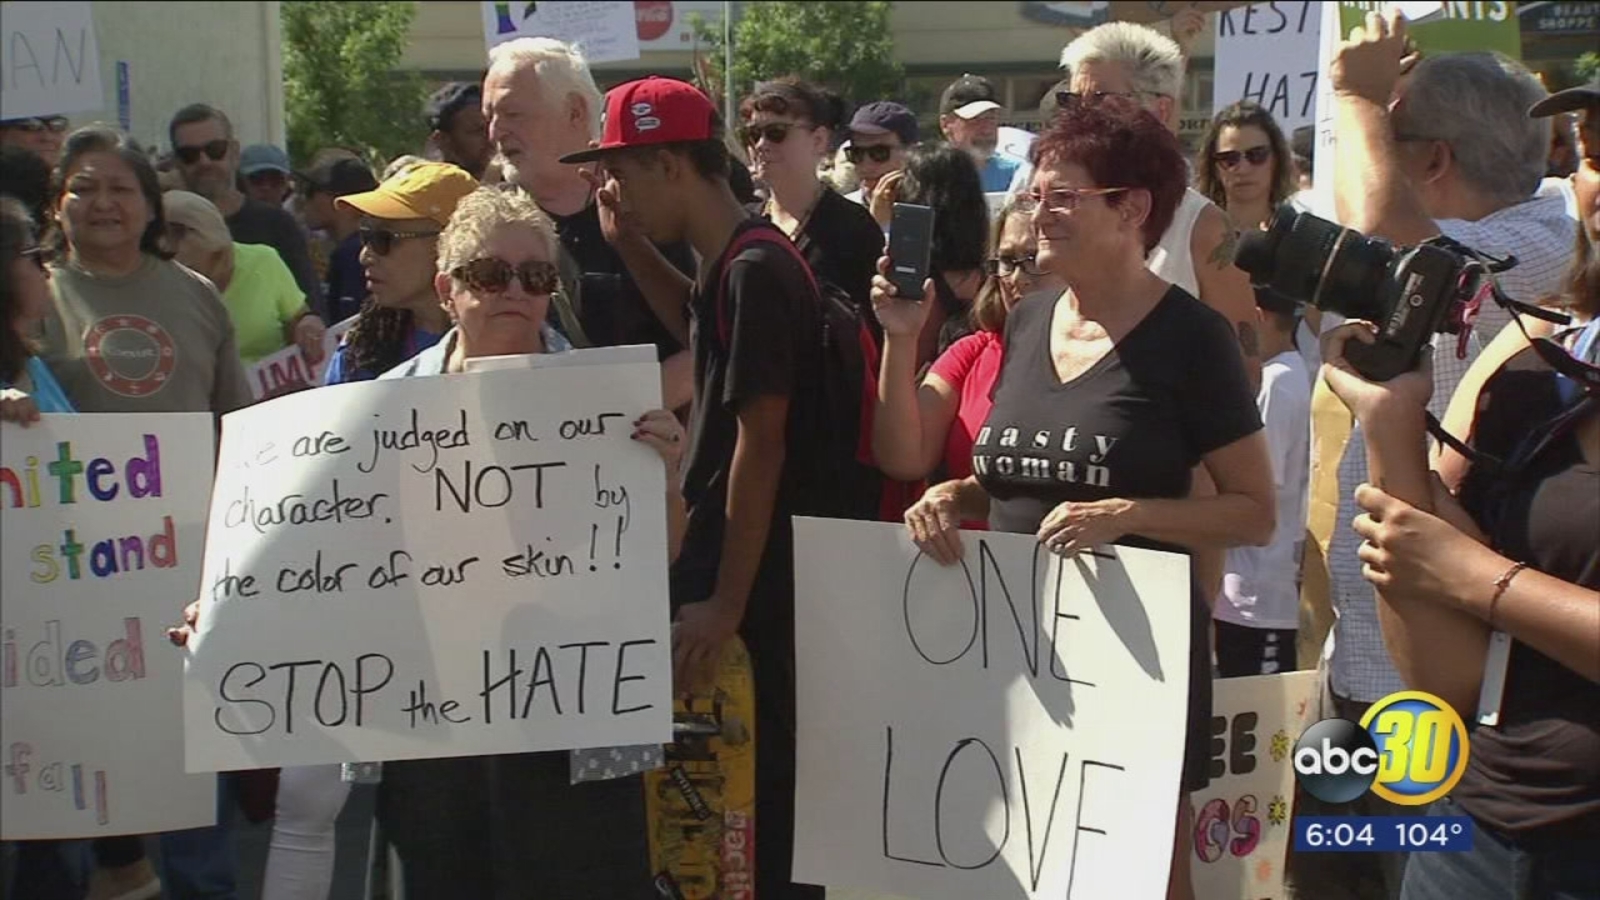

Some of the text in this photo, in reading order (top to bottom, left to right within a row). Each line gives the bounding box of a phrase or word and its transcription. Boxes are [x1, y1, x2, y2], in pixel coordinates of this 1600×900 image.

[1243, 71, 1318, 118] HAT
[292, 430, 351, 458] are
[358, 408, 470, 474] judged
[494, 418, 538, 442] on
[560, 411, 625, 441] our
[973, 455, 1111, 487] woman
[976, 426, 1118, 462] nasty
[225, 460, 631, 534] character. NOT by
[30, 516, 178, 585] stand
[211, 557, 261, 604] the
[276, 549, 359, 594] color
[368, 549, 415, 589] of
[421, 556, 480, 586] our
[903, 538, 1117, 687] ONE
[214, 638, 657, 736] STOP the HATE
[5, 741, 109, 825] fall
[883, 725, 1126, 900] LOVE
